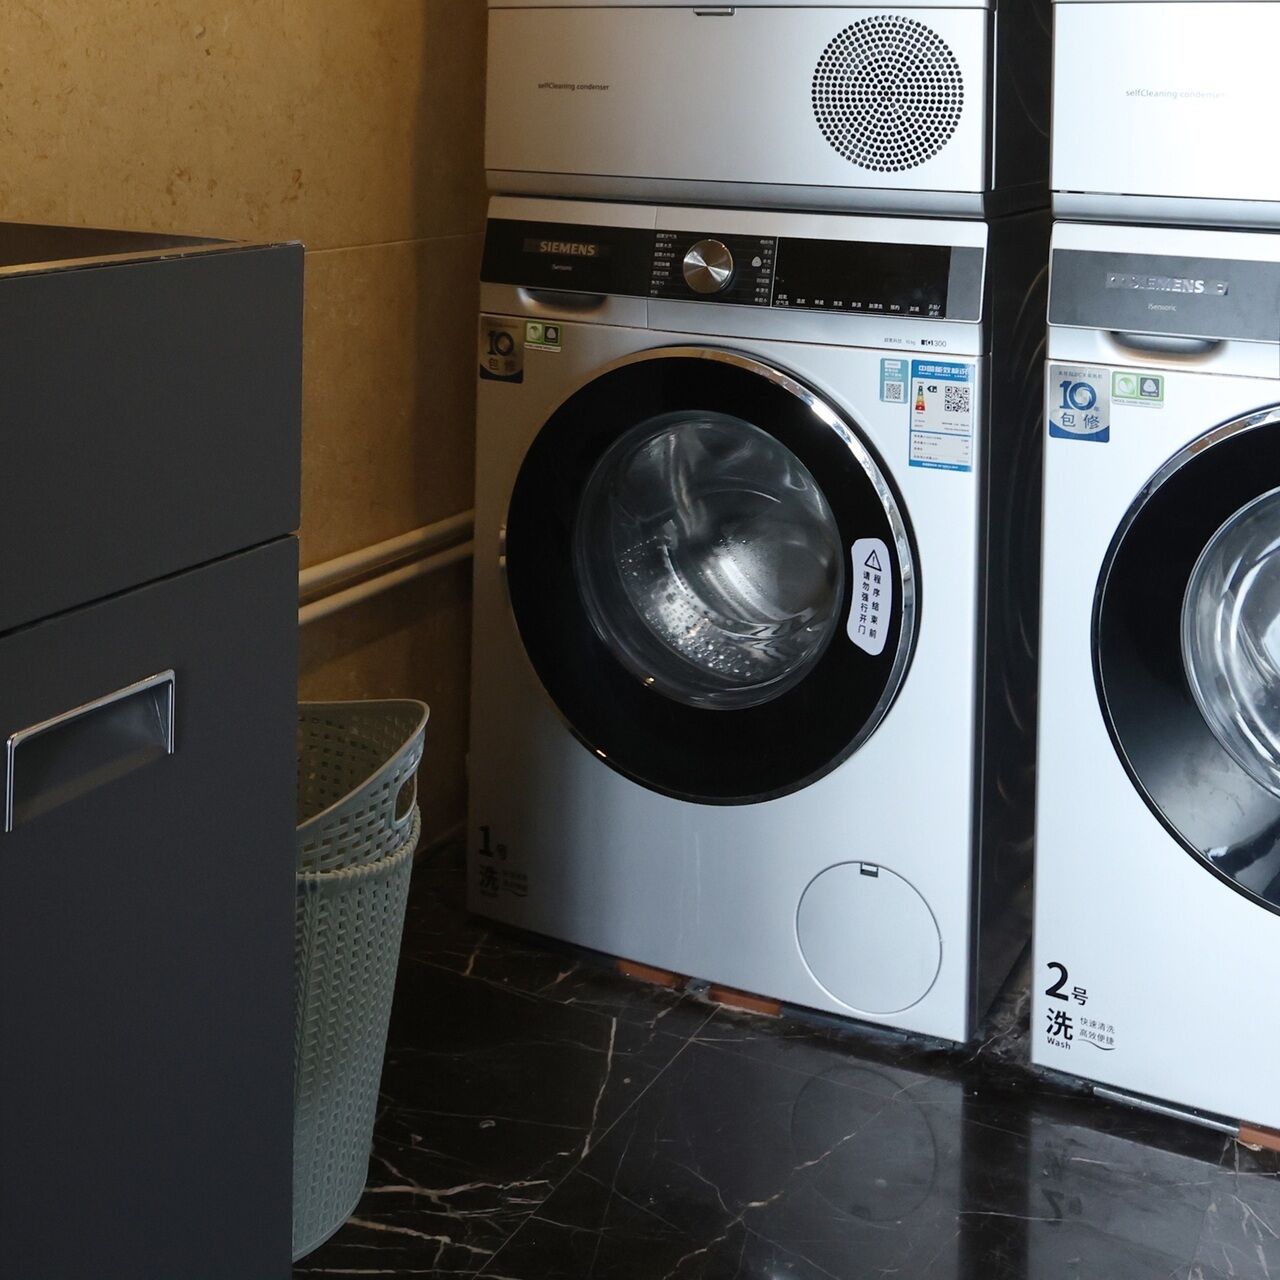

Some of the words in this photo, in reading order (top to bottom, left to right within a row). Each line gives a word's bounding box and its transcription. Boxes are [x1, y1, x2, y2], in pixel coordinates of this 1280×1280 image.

[1125, 88, 1178, 99] selfCleaning
[539, 240, 596, 256] SIEMENS
[1061, 412, 1100, 429] 包修
[857, 570, 870, 635] 请勿强行开门
[868, 573, 881, 639] 程序结束前
[1045, 961, 1088, 1006] 2号
[1046, 1007, 1074, 1040] 洗
[1080, 1016, 1115, 1034] 快速清洗
[1047, 1036, 1071, 1050] Wash
